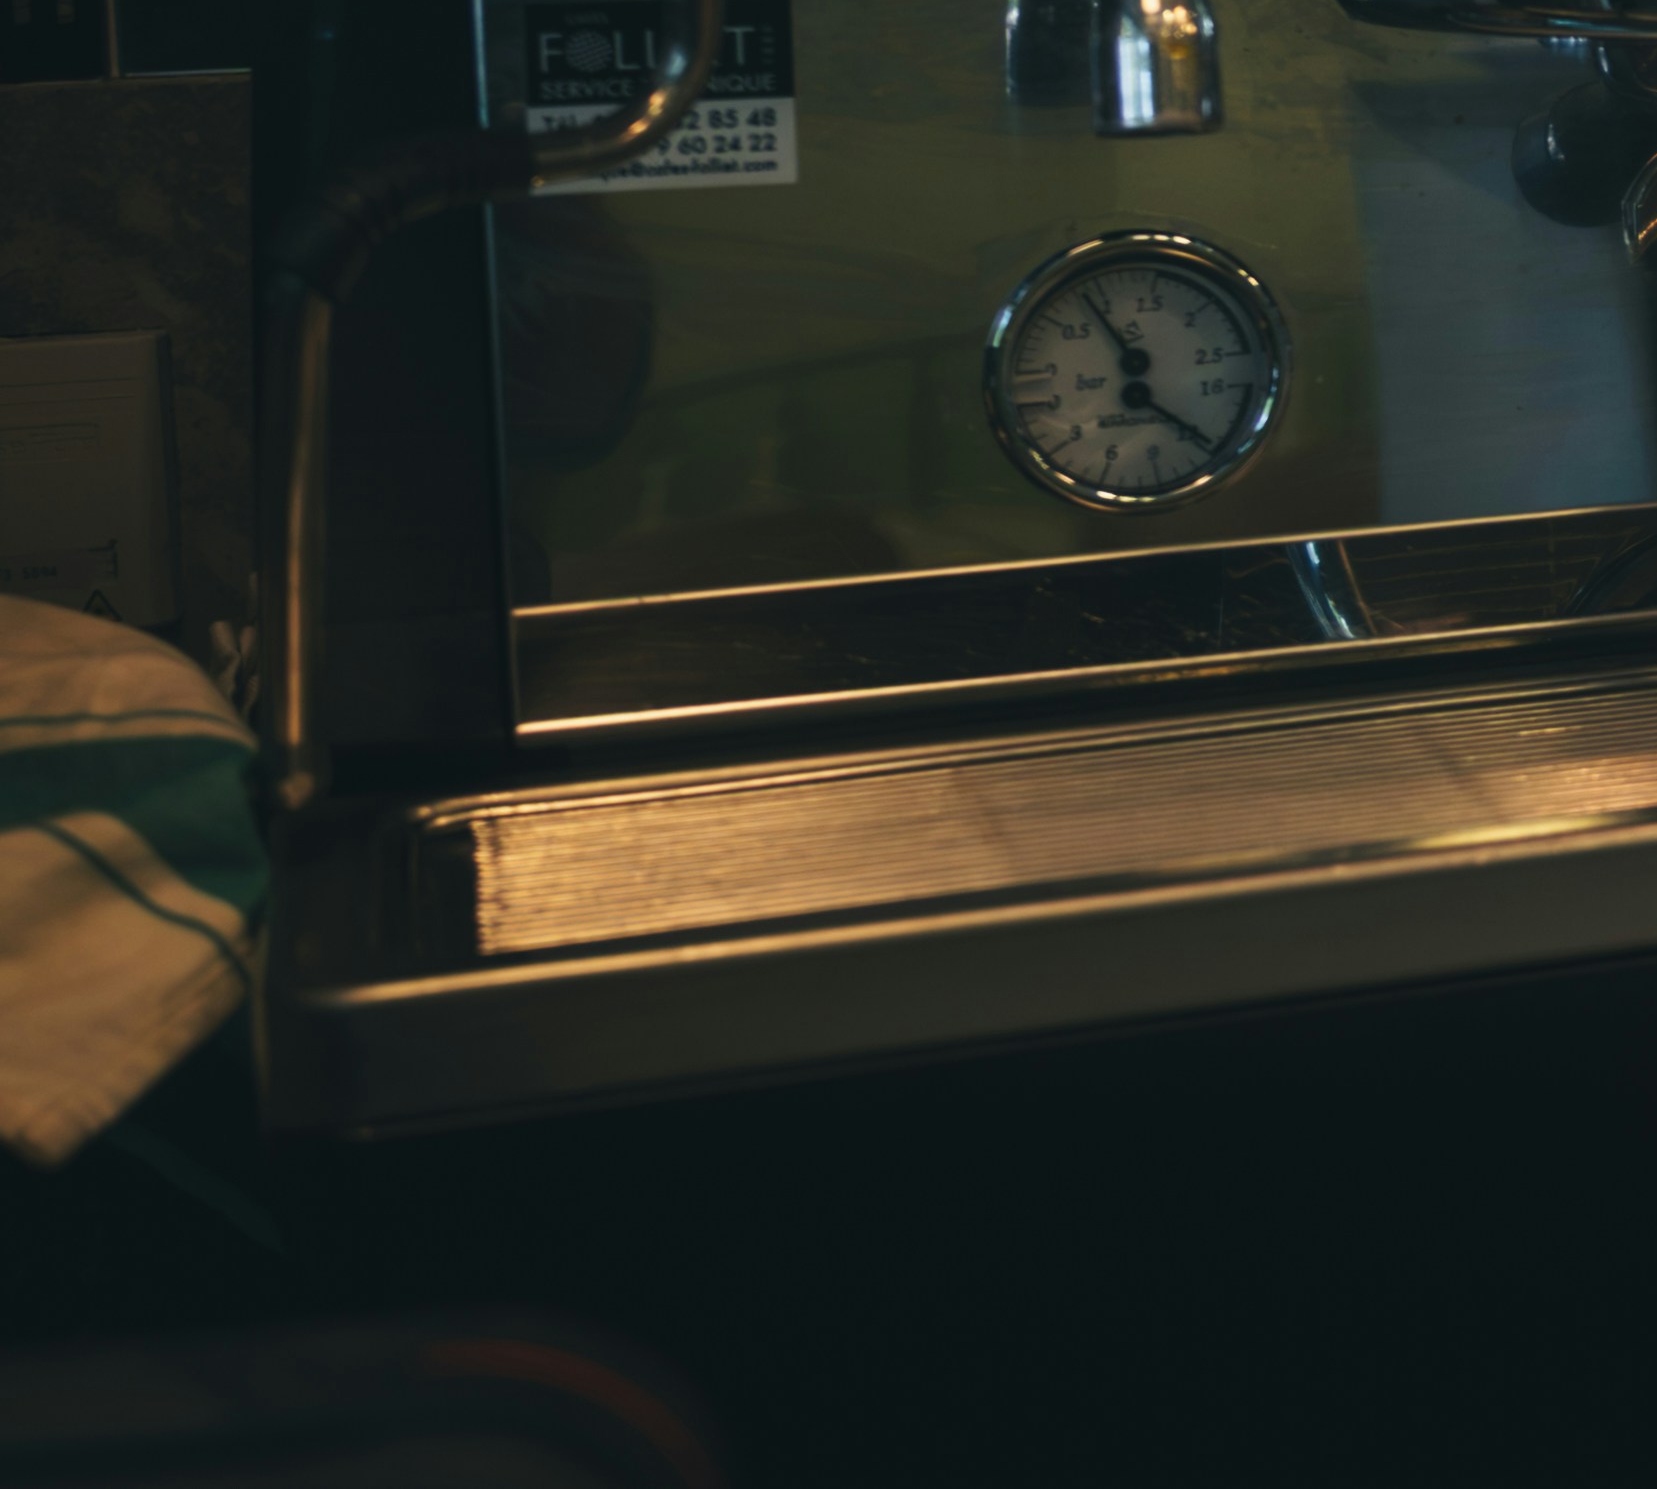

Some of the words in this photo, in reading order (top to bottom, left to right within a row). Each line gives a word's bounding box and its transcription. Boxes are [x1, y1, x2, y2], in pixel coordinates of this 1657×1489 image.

[541, 78, 634, 99] SERVICE
[708, 109, 738, 128] 85
[746, 107, 777, 126] 48
[678, 136, 707, 156] 60
[750, 133, 778, 152] 22
[1137, 296, 1164, 313] 1.5
[1062, 323, 1091, 340] 0.5
[1195, 347, 1224, 365] 2.5
[1075, 373, 1107, 391] bar
[1201, 379, 1224, 396] 16
[1070, 425, 1081, 441] 3
[1106, 444, 1118, 460] 6
